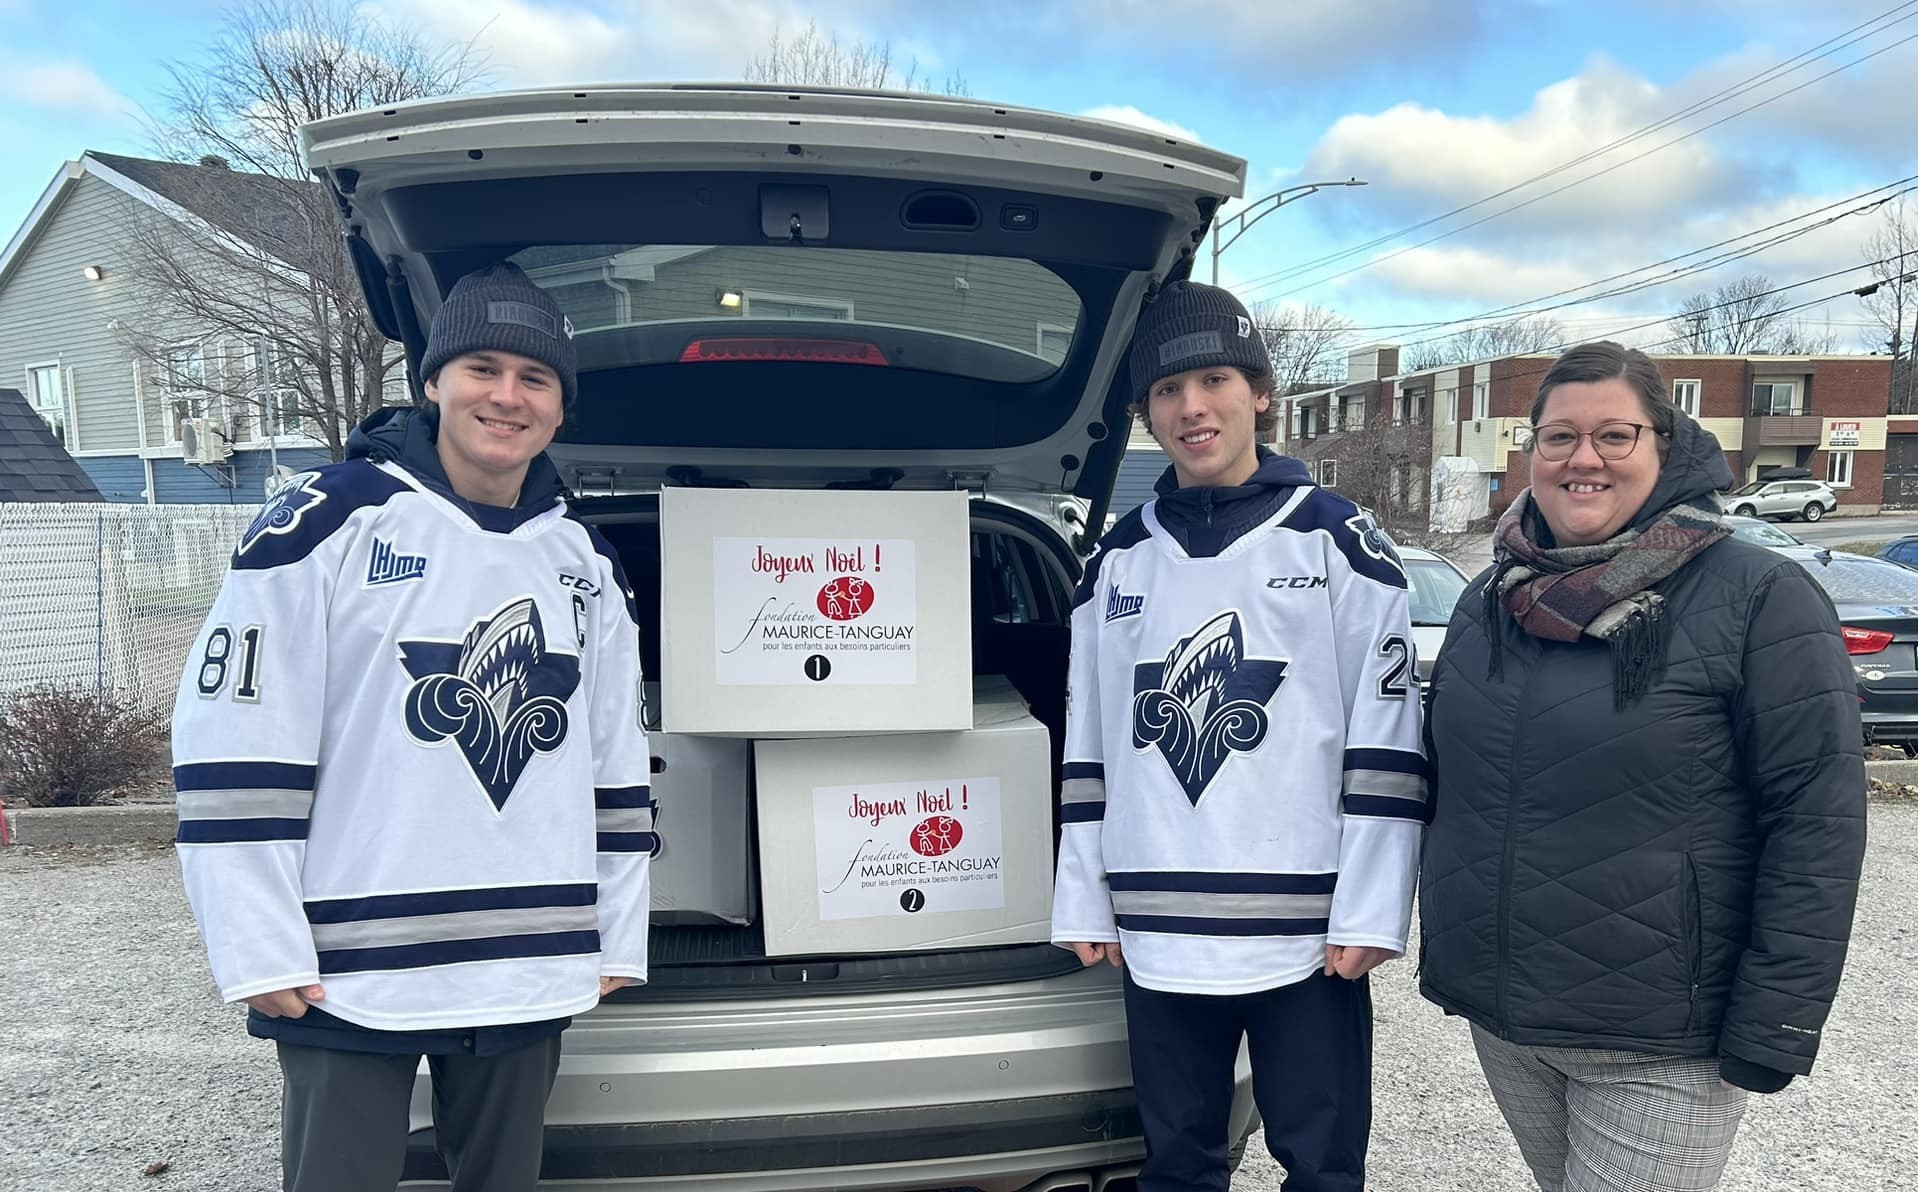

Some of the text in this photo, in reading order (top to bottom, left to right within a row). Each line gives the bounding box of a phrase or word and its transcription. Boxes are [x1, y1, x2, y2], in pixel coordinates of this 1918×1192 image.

[752, 543, 881, 583] Joyeux Noël !
[1266, 576, 1329, 589] CCM
[720, 596, 817, 654] fondation
[762, 625, 914, 640] MAURICE-TANGUAY
[762, 642, 779, 651] pour
[781, 641, 793, 650] les
[794, 641, 823, 650] enfants
[839, 642, 868, 651] besoins
[869, 642, 911, 652] particuliers
[197, 624, 264, 702] 81
[848, 784, 968, 827] Joyeux Noël !
[861, 856, 1000, 878] MAURICE-TANGUAY
[861, 879, 877, 889] pour
[878, 878, 889, 887] les
